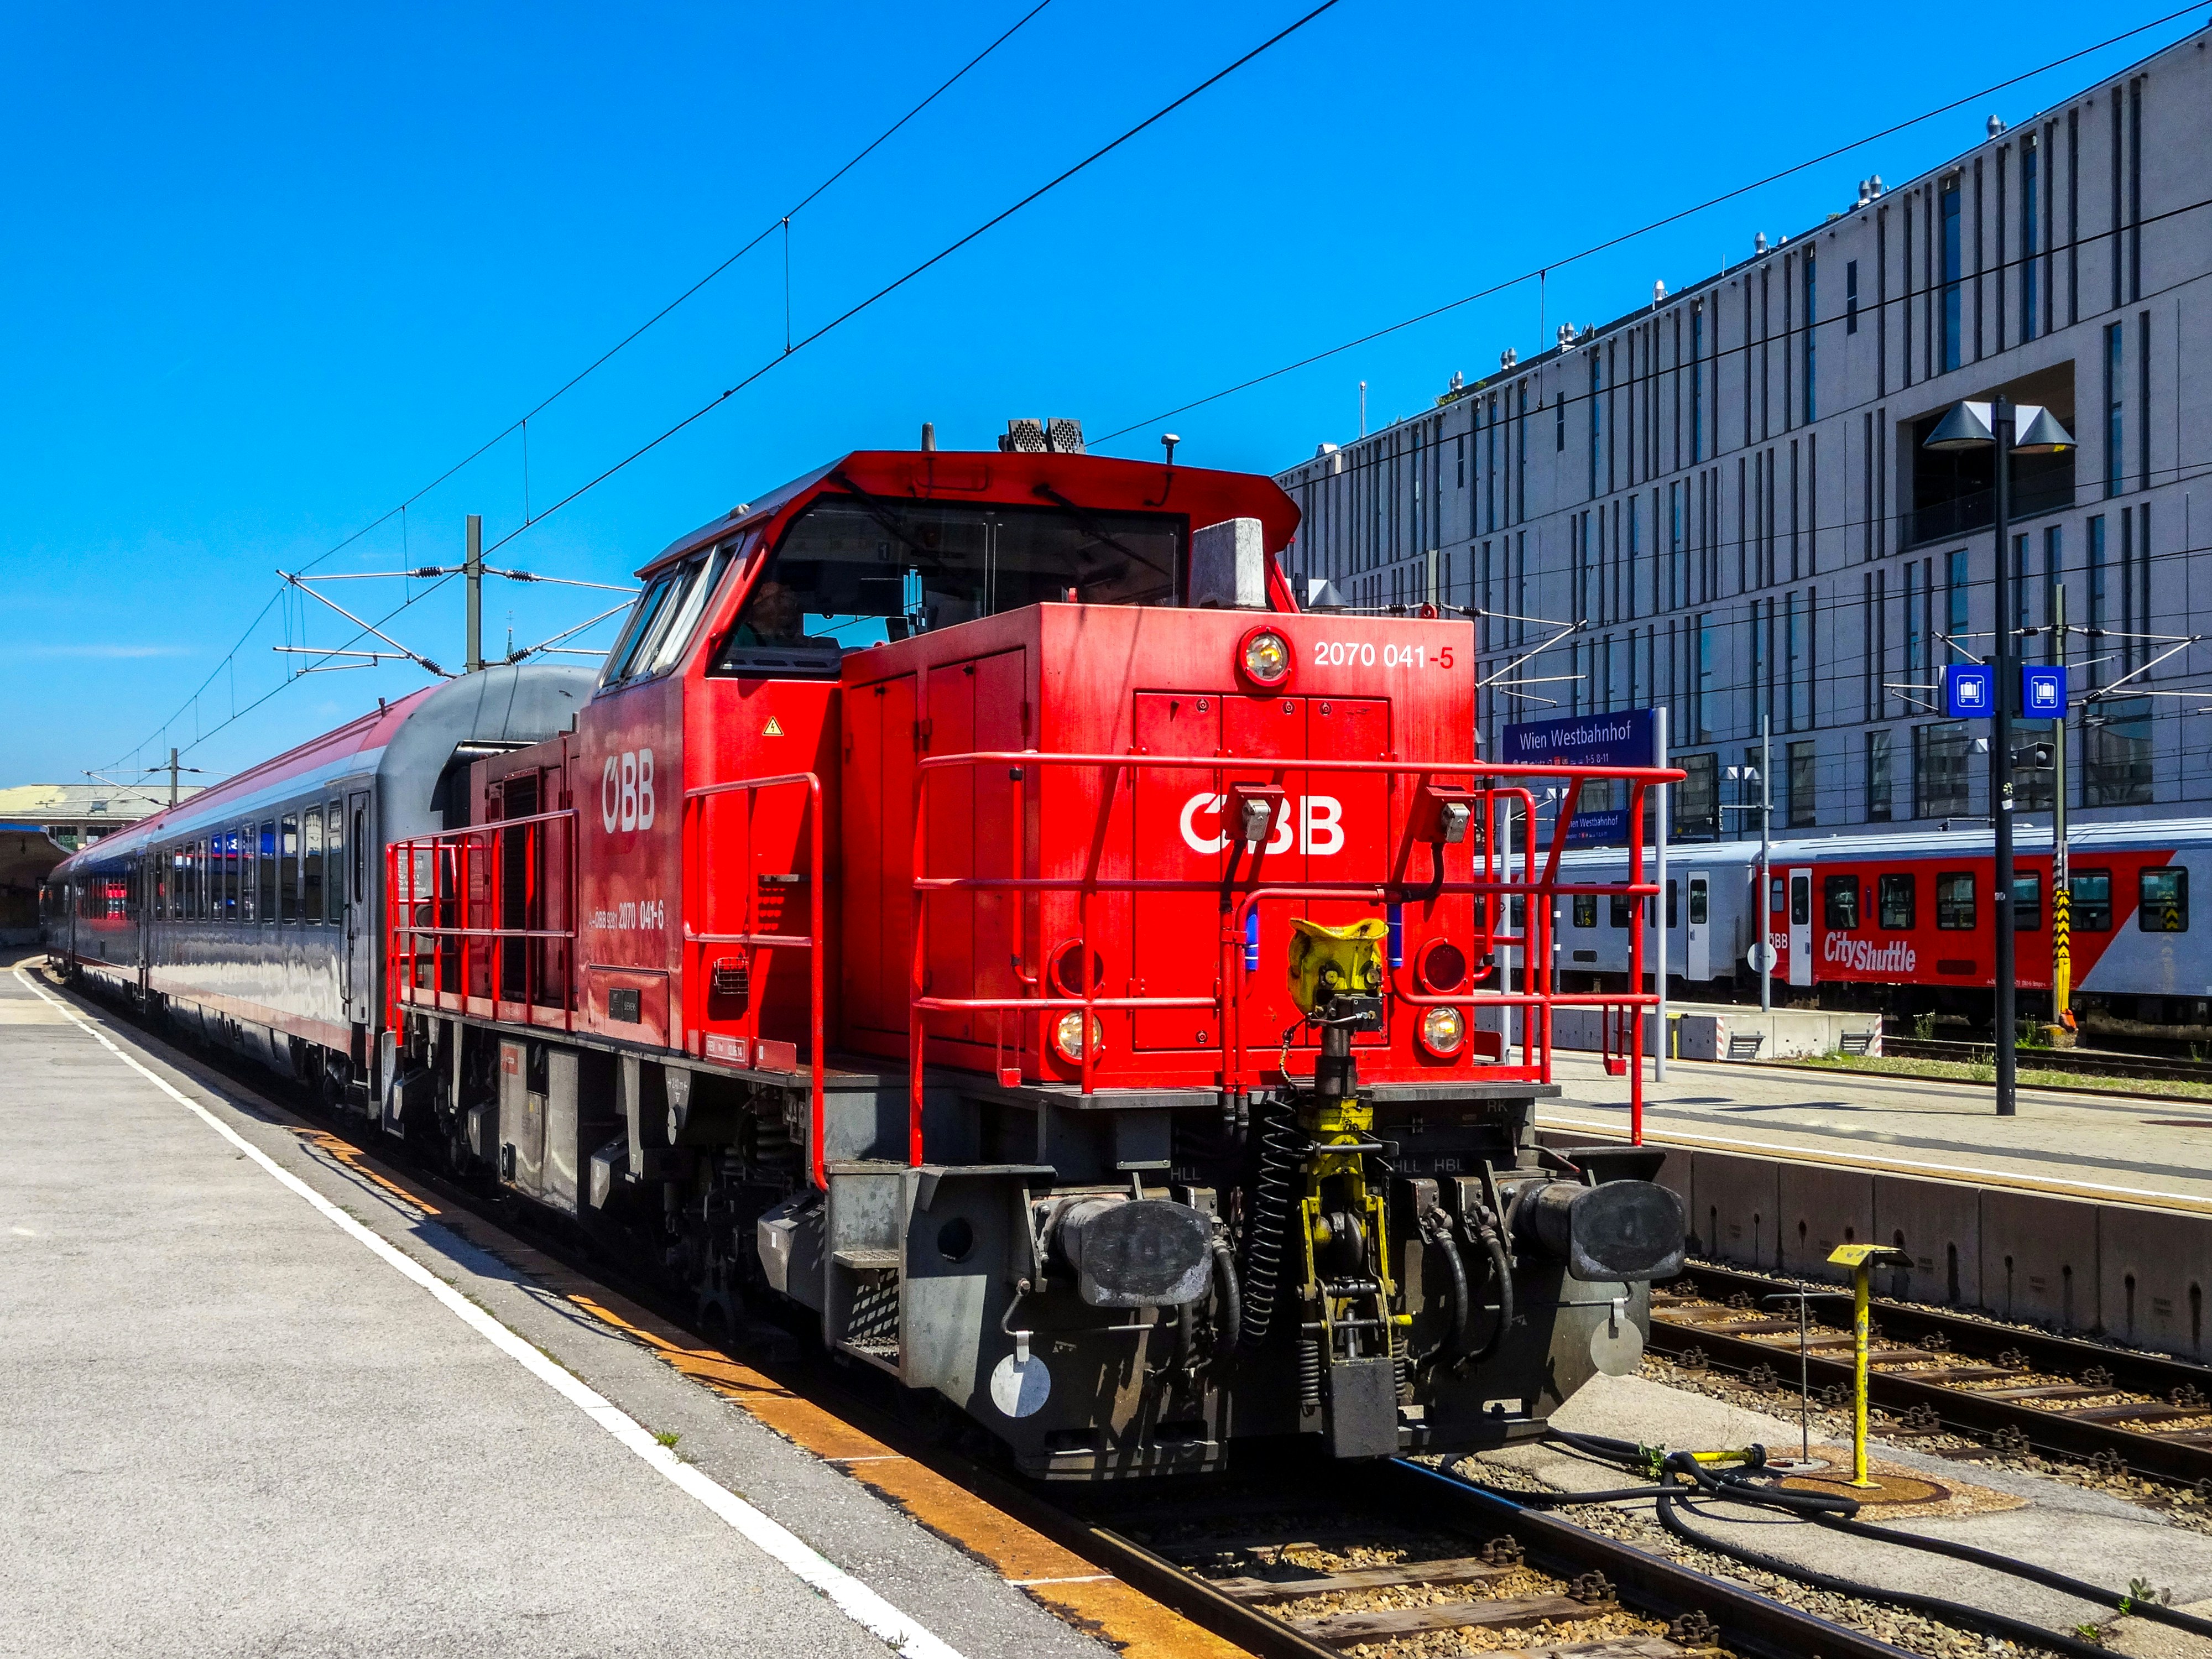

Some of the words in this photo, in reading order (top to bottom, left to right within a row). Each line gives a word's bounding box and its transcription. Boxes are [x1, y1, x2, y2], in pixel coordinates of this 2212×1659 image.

[1314, 641, 1376, 666] 2070
[1520, 731, 1547, 750] Wien
[1550, 719, 1631, 748] Westbahnhof
[602, 748, 655, 834] ÖBB
[1579, 814, 1618, 828] Westbahnhof
[619, 901, 635, 930] 2070
[640, 899, 664, 930] 041-6
[1486, 1099, 1508, 1112] RK
[1171, 1167, 1202, 1181] HLL
[1434, 1159, 1464, 1172] HBL
